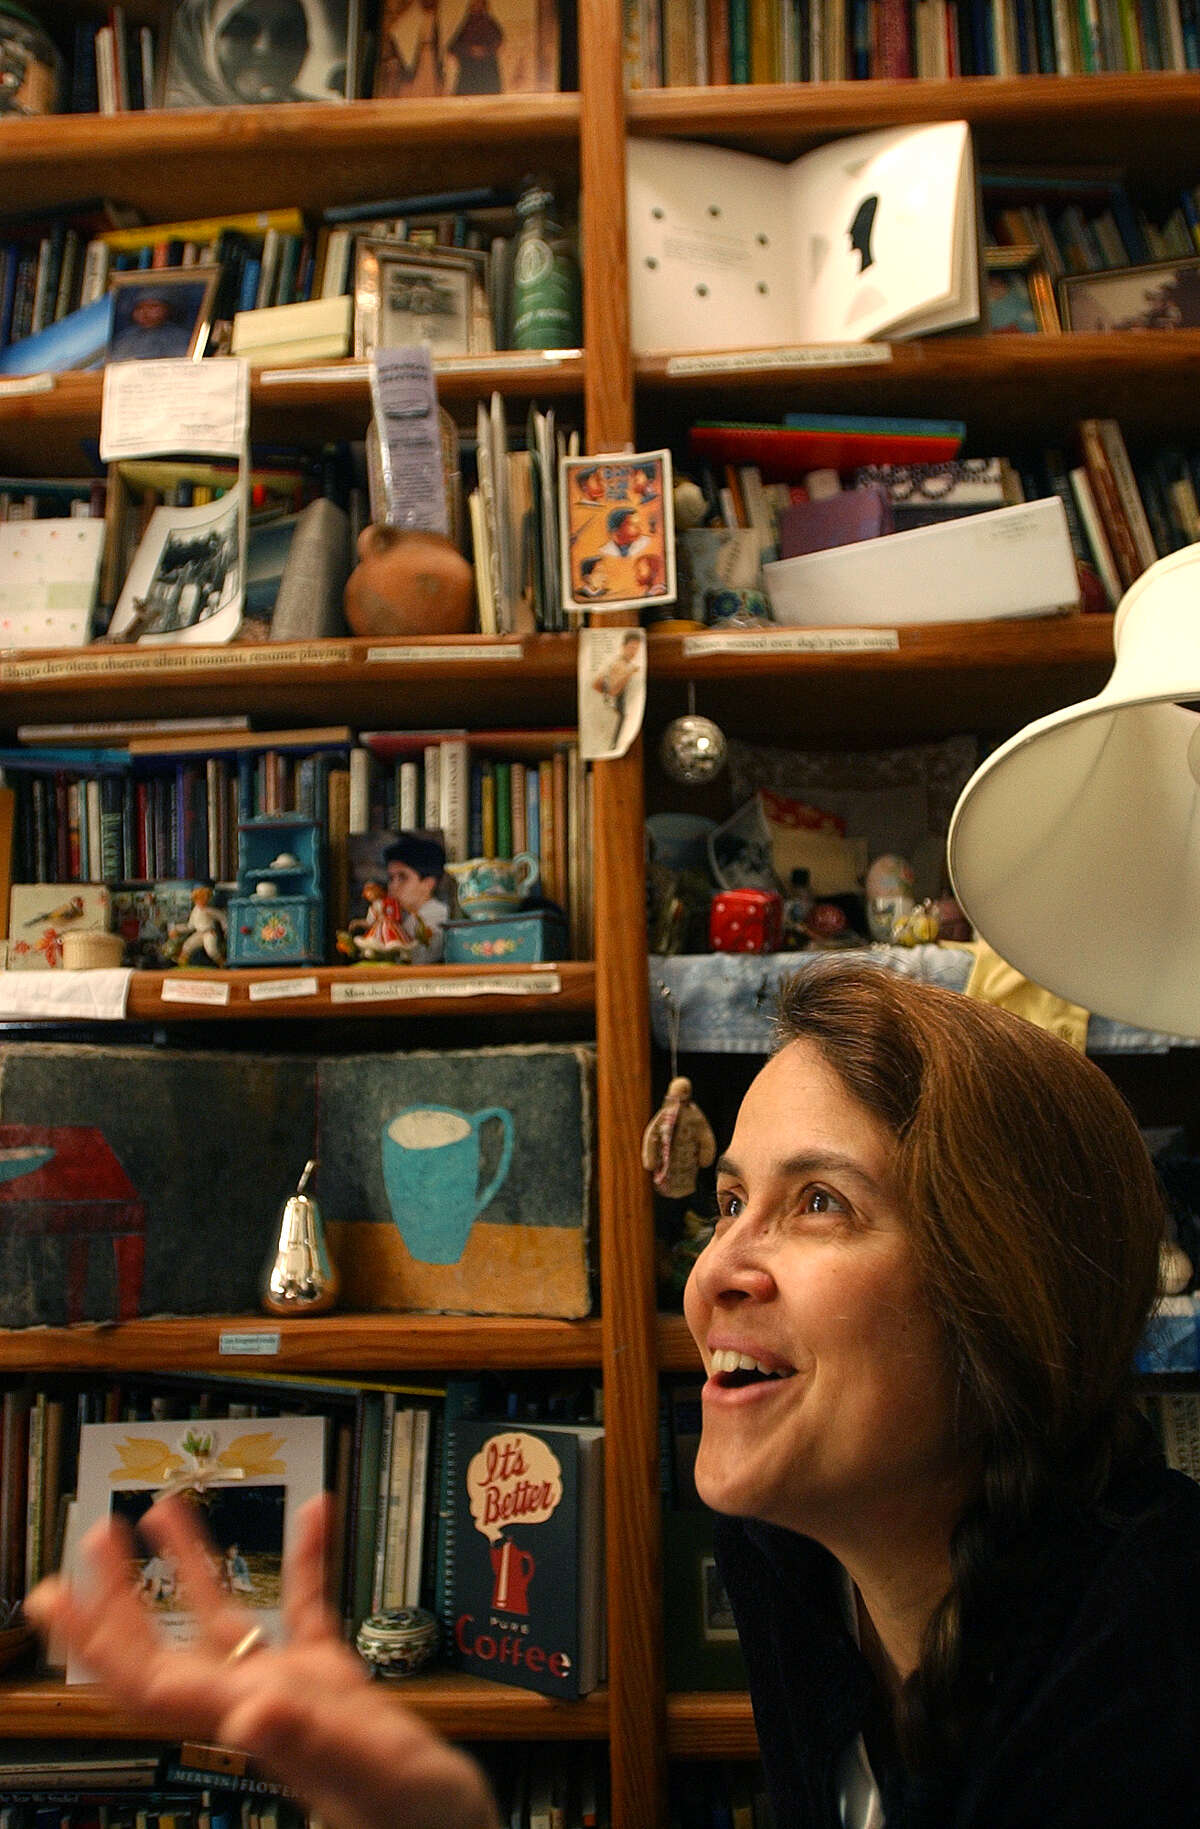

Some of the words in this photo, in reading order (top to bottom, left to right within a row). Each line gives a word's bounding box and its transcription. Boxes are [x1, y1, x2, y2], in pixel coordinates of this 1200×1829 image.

[42, 661, 99, 674] devotees
[101, 658, 150, 670] observe
[154, 656, 187, 667] silent
[249, 652, 296, 664] resume
[299, 649, 348, 662] playing
[477, 1438, 529, 1487] It's
[482, 1480, 554, 1527] Better
[454, 1613, 573, 1679] Coffee
[489, 1616, 531, 1635] PURE
